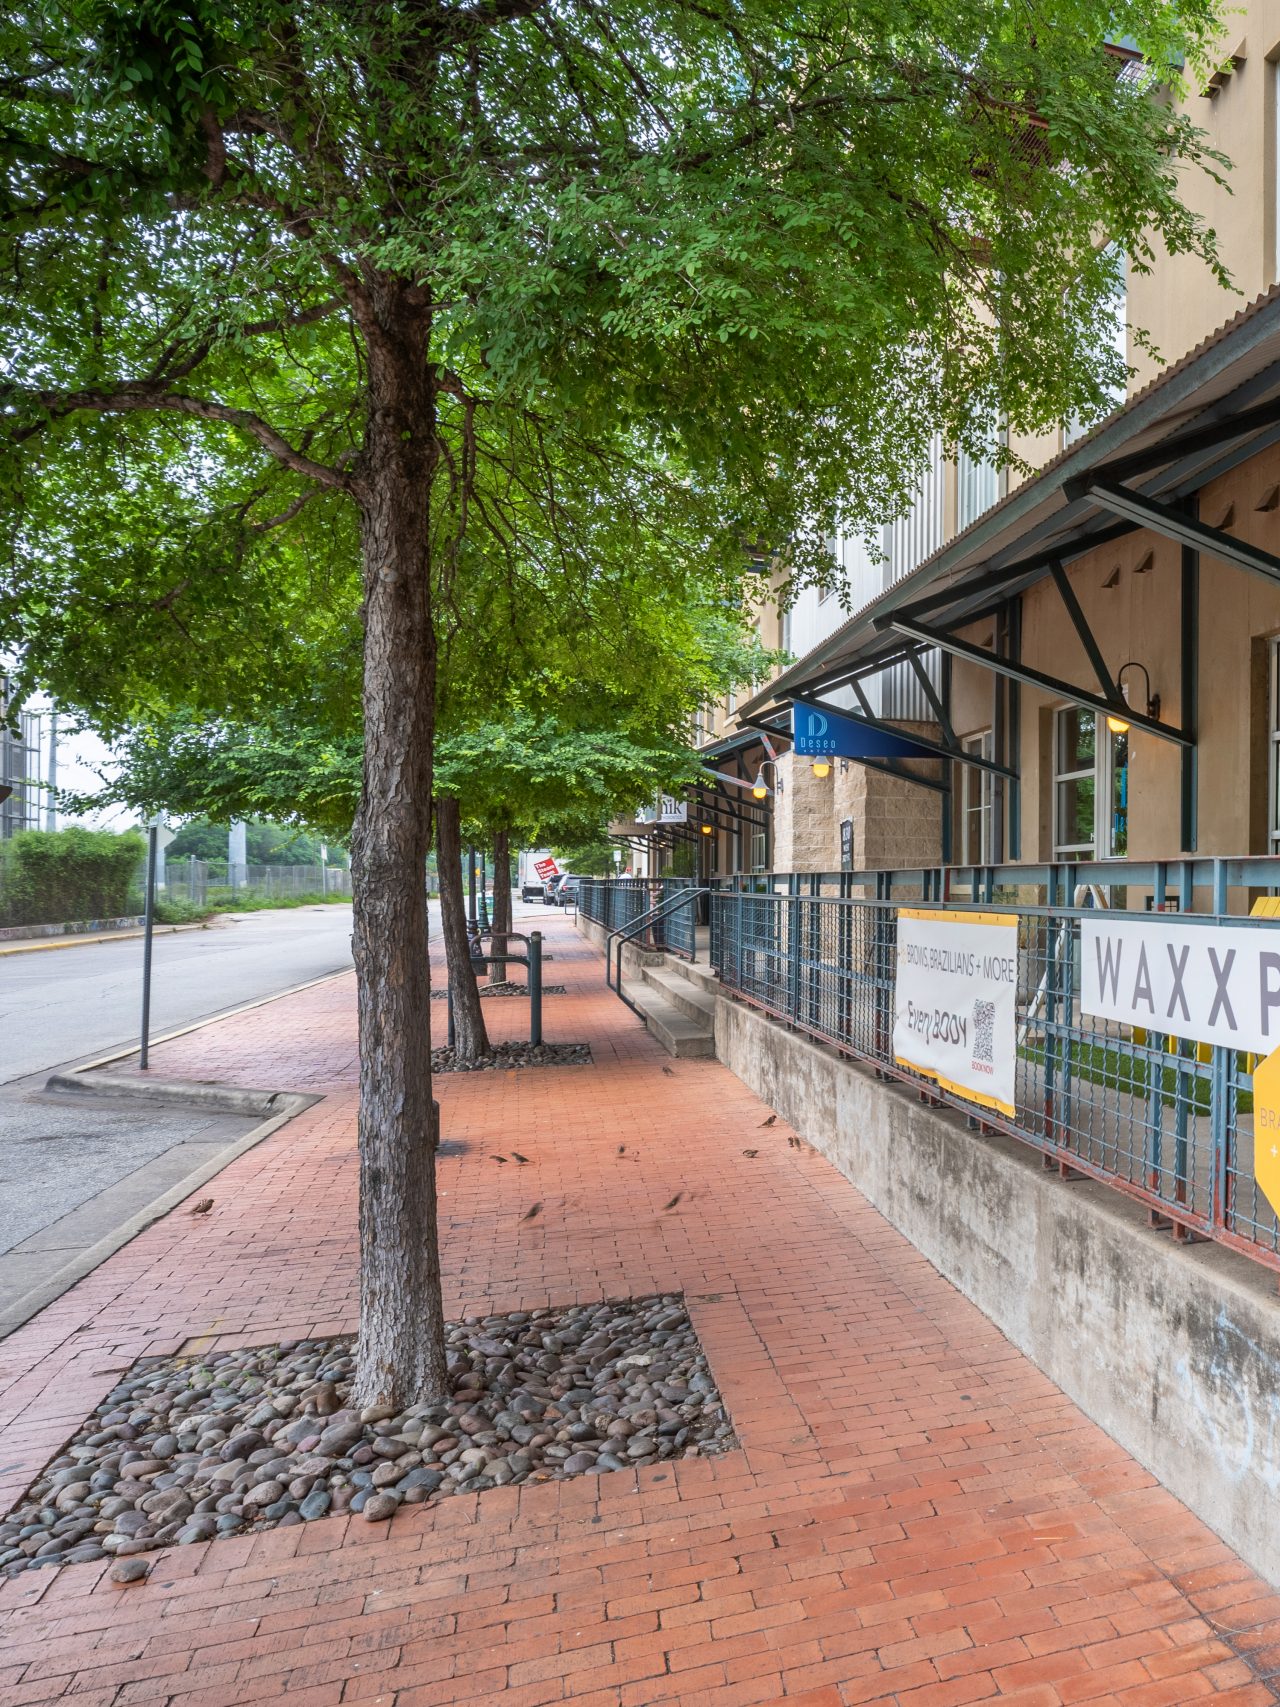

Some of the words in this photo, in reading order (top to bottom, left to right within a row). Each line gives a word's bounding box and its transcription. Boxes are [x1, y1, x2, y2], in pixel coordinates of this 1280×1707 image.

[800, 737, 836, 749] Deseo
[929, 948, 975, 977] BRAZILIANS
[983, 955, 1014, 982] MORE
[907, 1000, 933, 1045] Every
[932, 1009, 967, 1048] BODY
